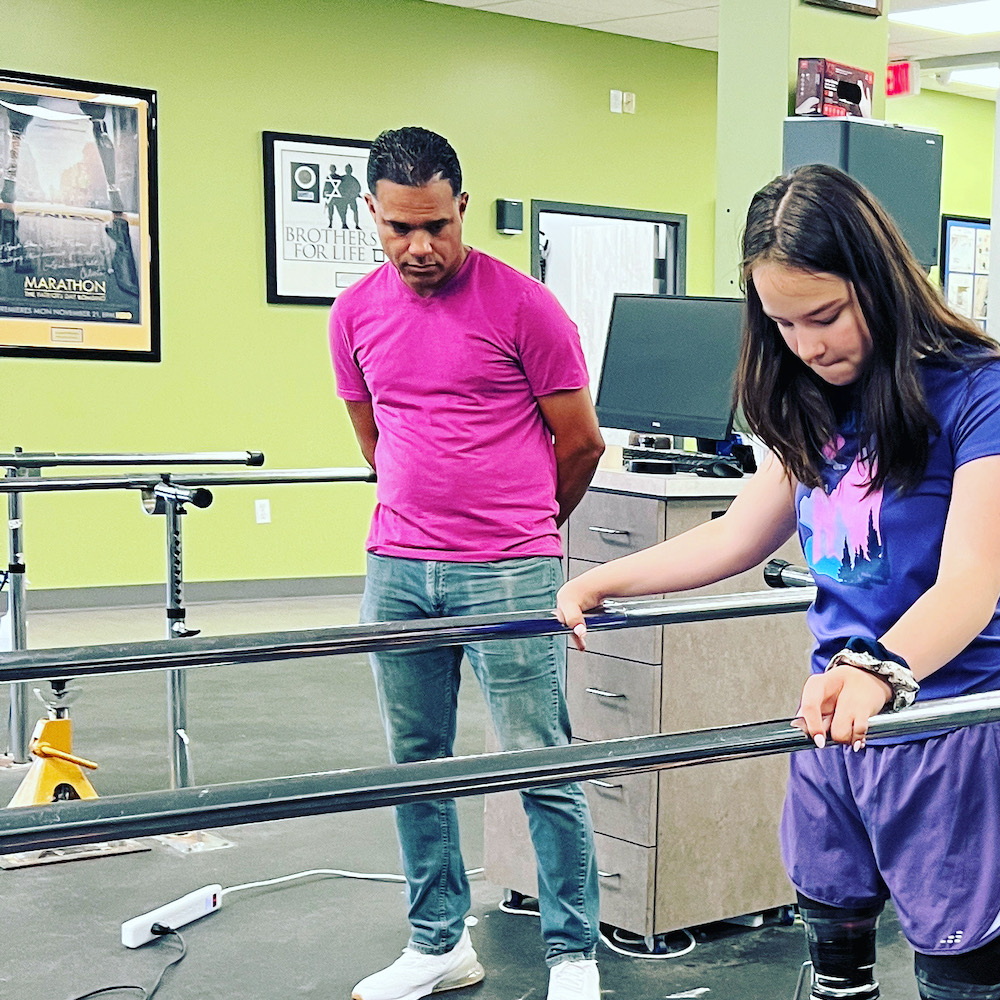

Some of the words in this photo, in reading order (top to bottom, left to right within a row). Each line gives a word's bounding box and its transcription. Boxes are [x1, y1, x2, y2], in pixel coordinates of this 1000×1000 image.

[285, 226, 377, 247] BROTHERS
[294, 243, 329, 260] FOR
[333, 245, 366, 261] LIFE
[24, 276, 106, 294] MARATHON
